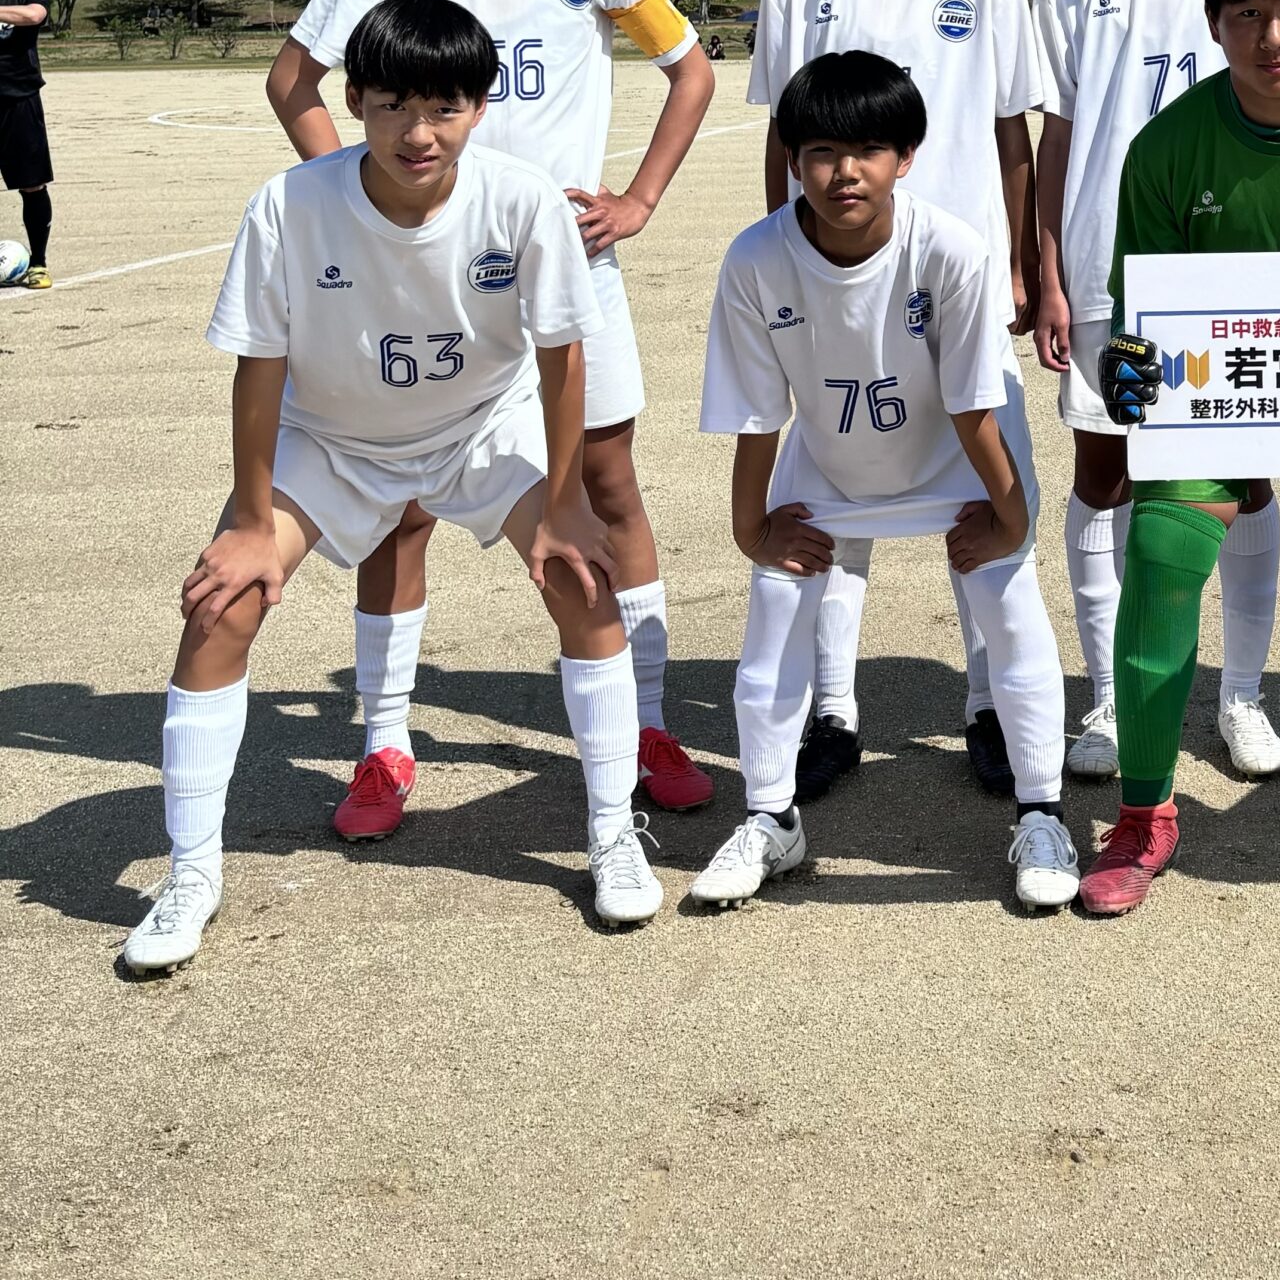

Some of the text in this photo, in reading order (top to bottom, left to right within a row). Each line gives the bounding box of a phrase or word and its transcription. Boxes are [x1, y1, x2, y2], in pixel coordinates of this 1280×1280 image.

[1092, 6, 1121, 18] Squadra
[938, 14, 973, 26] LIBRE
[1143, 52, 1197, 116] 71
[316, 278, 353, 289] Squadra
[769, 316, 805, 331] Squadra
[379, 332, 464, 388] 63
[824, 375, 908, 434] 76
